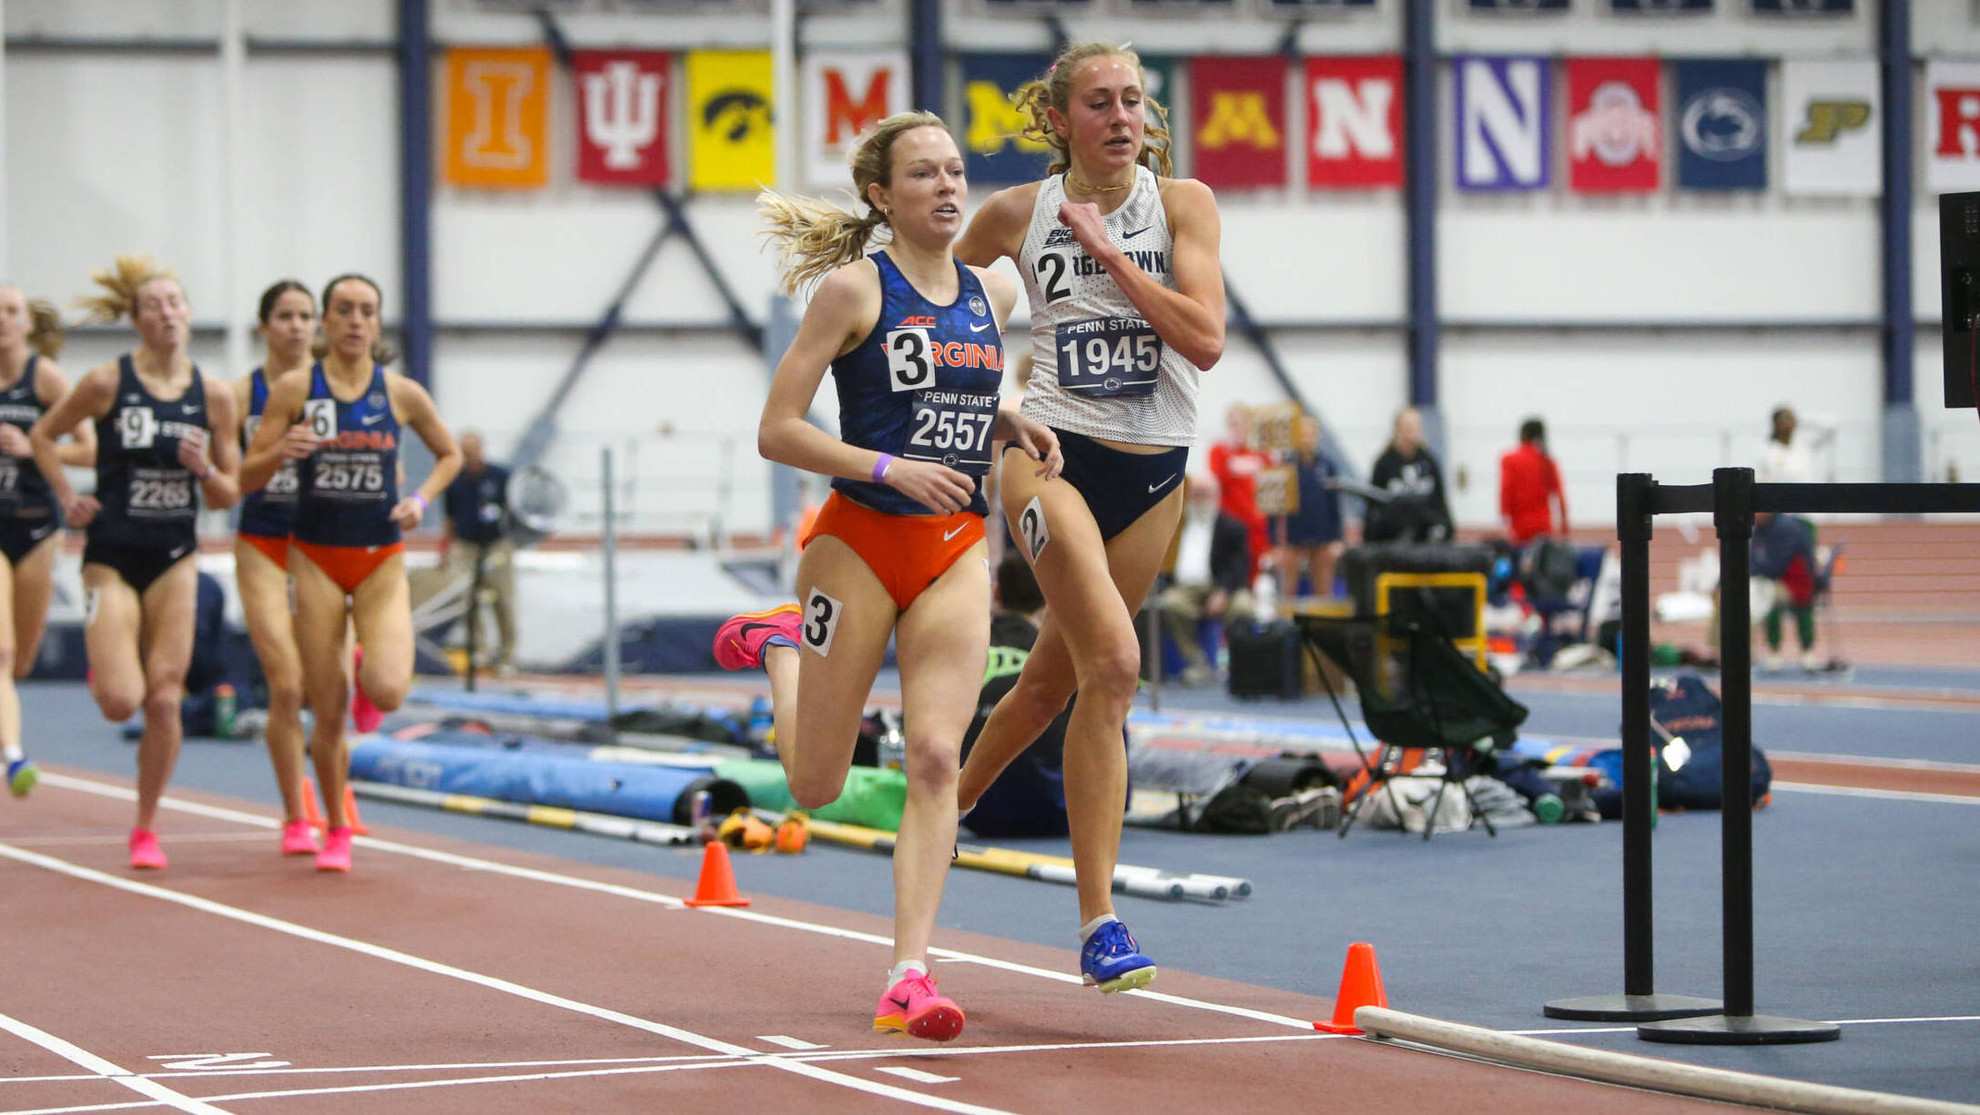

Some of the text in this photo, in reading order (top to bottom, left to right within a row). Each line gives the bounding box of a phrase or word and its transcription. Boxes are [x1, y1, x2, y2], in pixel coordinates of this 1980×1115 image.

[823, 68, 891, 150] M
[966, 80, 1052, 153] M
[1199, 93, 1278, 149] M
[1315, 79, 1394, 159] N
[1463, 60, 1541, 184] N
[1038, 253, 1071, 304] 2
[900, 316, 936, 325] ACC
[1067, 319, 1151, 334] PENN STATE
[894, 333, 928, 385] 3
[1062, 335, 1158, 376] 1945
[312, 404, 328, 436] 6
[924, 391, 992, 407] PENN STATE
[128, 412, 143, 442] 9
[910, 408, 994, 451] 2557
[314, 462, 383, 491] 2575
[1023, 508, 1045, 560] 2
[806, 595, 833, 647] 3
